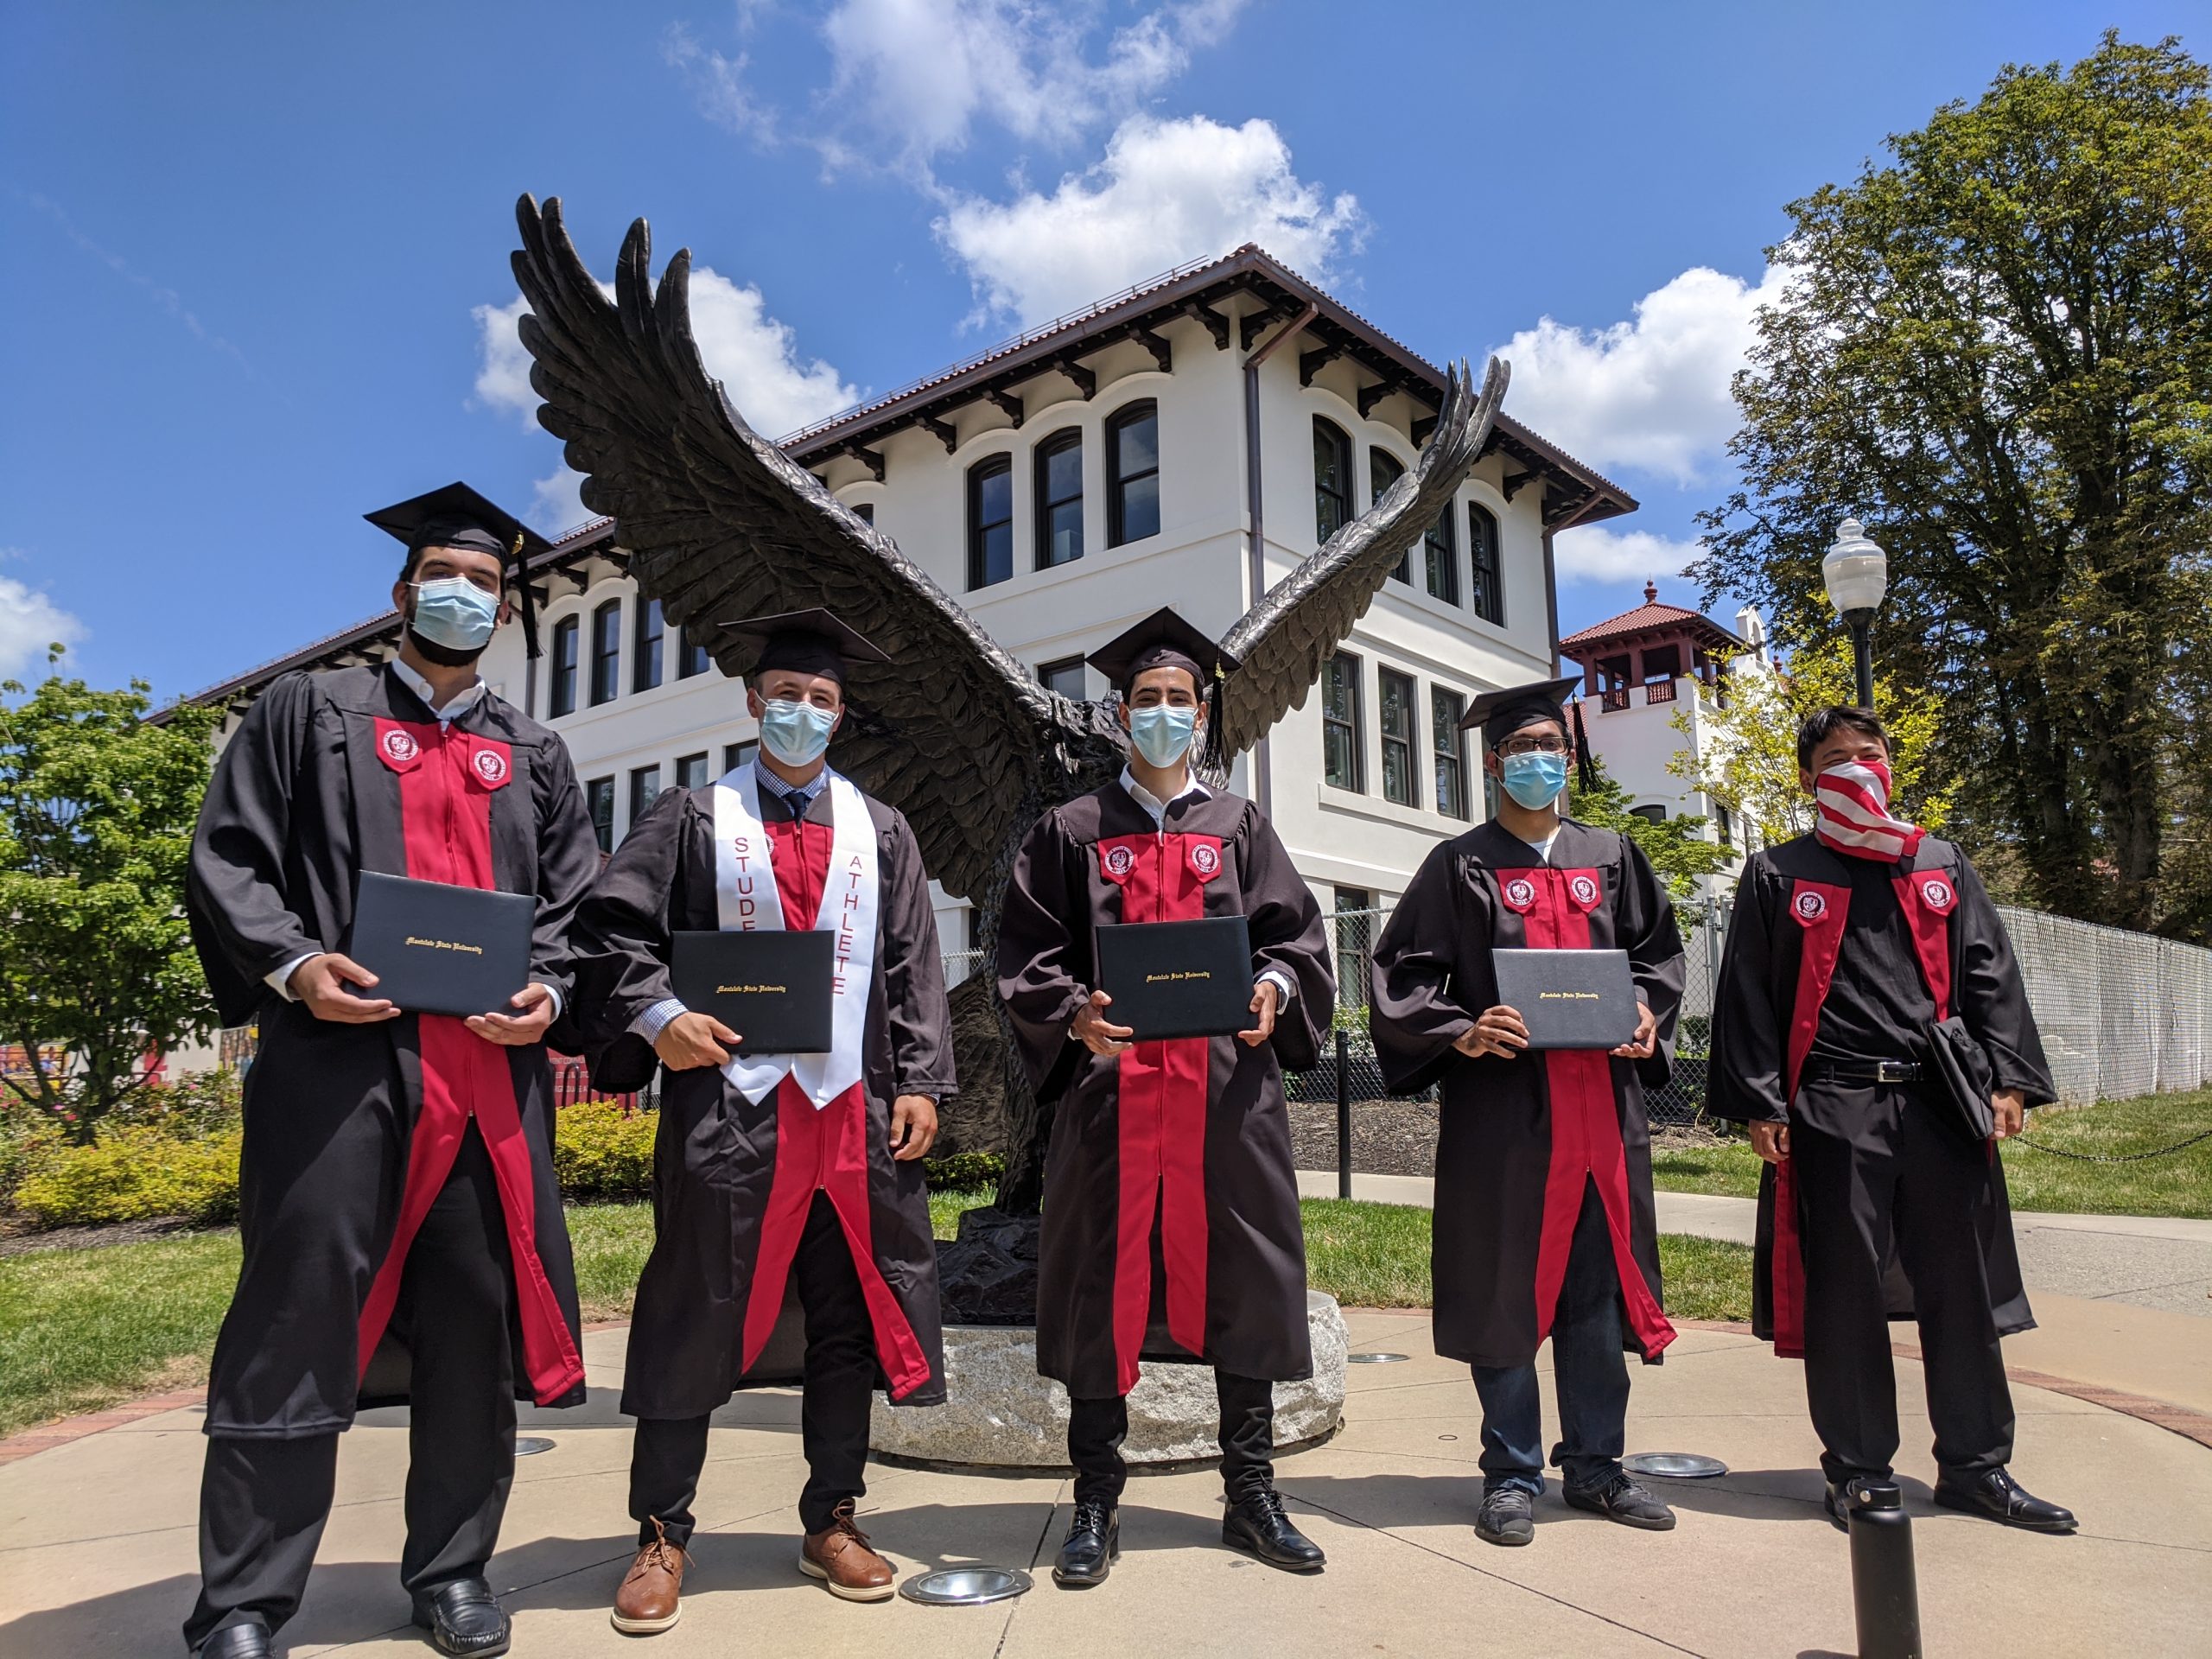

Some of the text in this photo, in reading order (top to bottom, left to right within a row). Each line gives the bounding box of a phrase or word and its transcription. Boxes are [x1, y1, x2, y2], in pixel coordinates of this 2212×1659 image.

[734, 836, 756, 931] STUDE
[831, 855, 862, 995] ATHLETE
[435, 940, 452, 949] State
[452, 943, 482, 955] University
[1185, 971, 1210, 980] University
[759, 985, 786, 994] University
